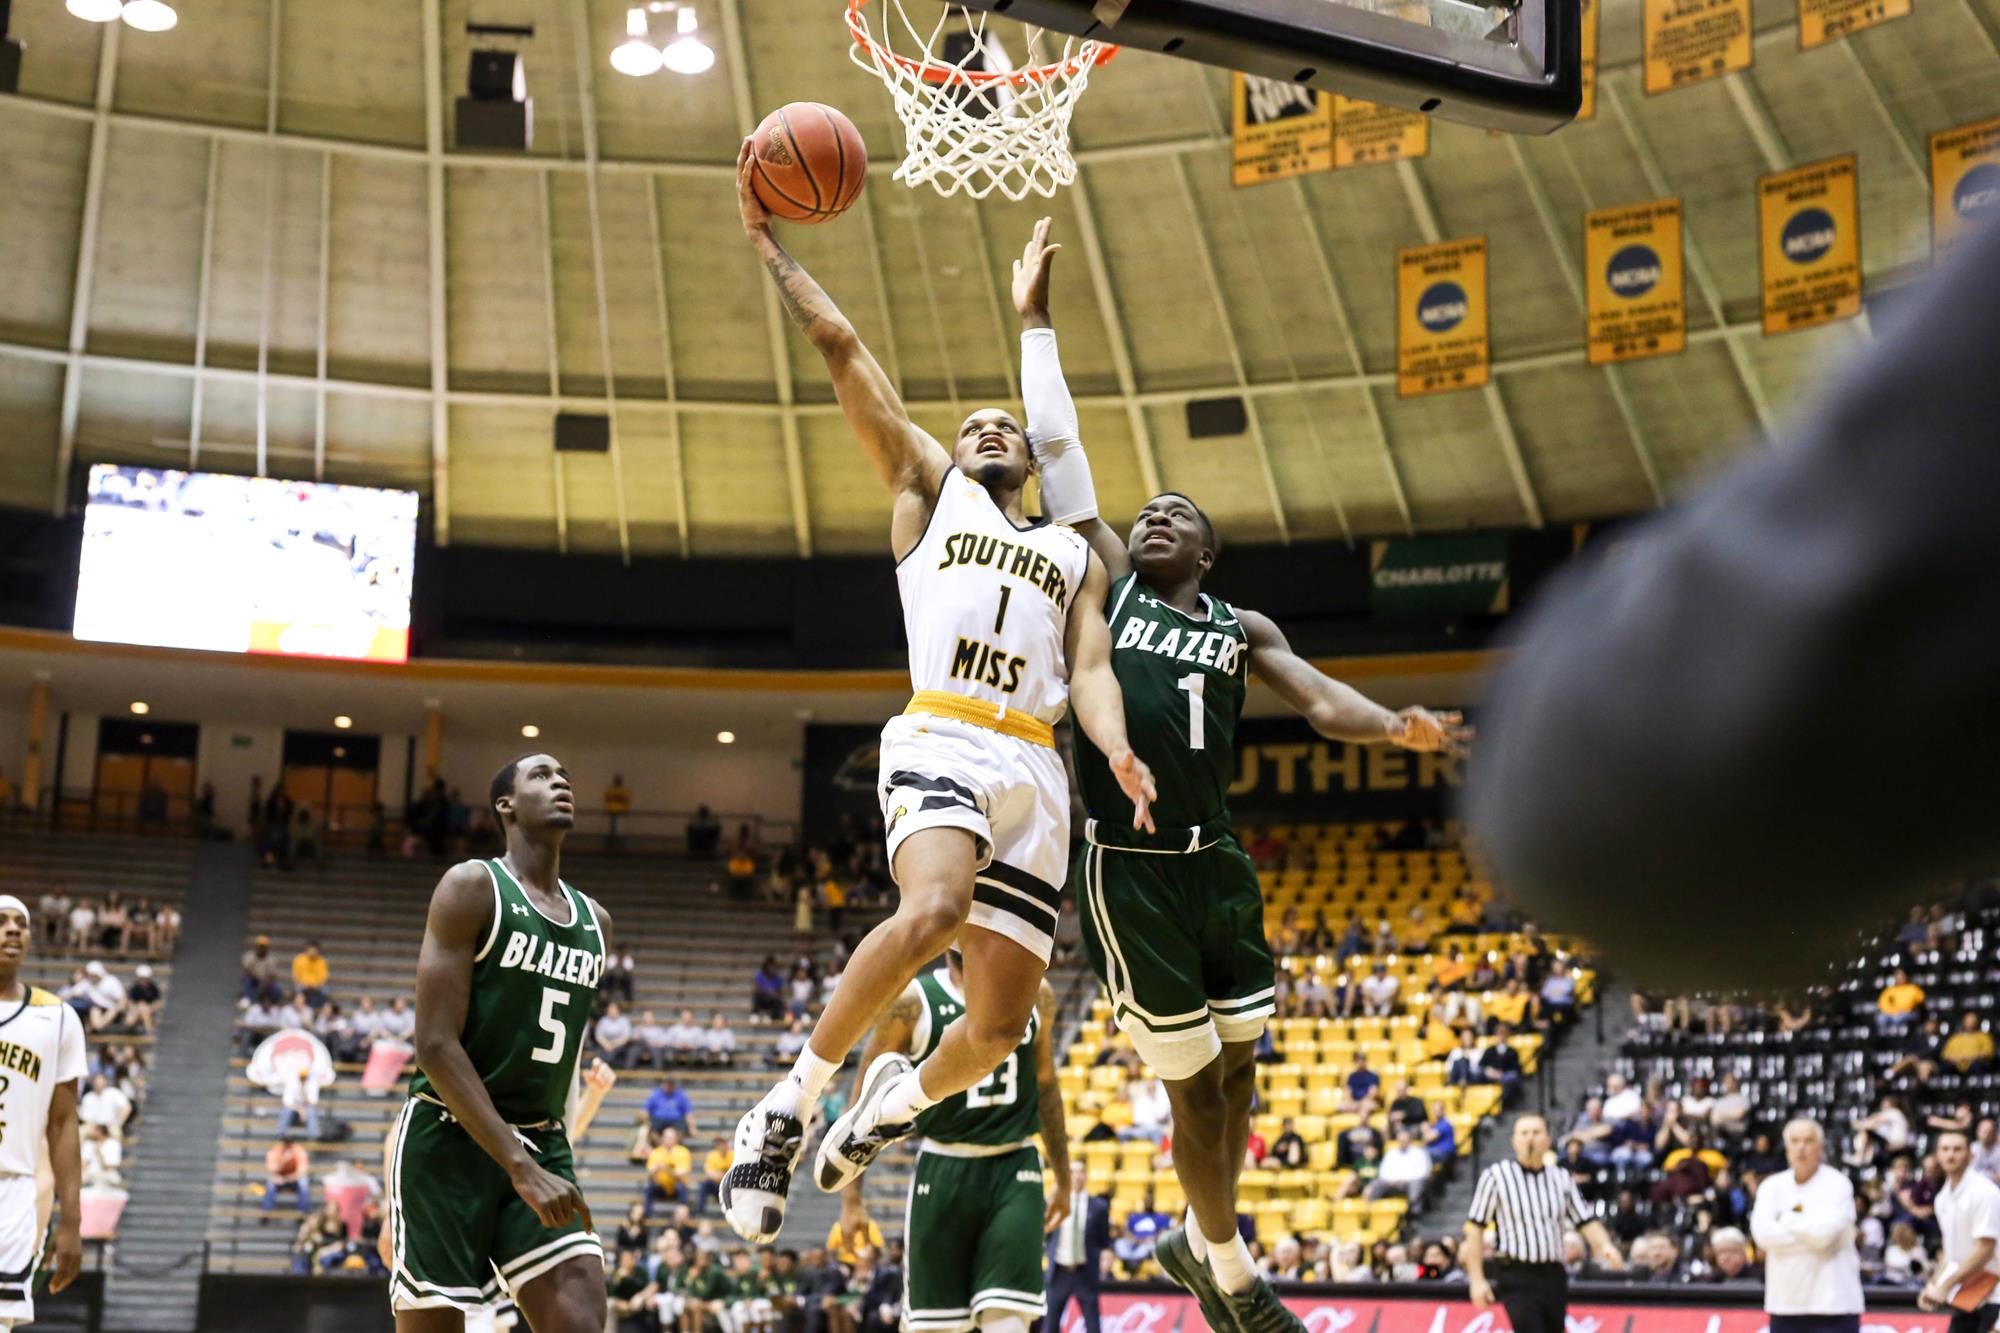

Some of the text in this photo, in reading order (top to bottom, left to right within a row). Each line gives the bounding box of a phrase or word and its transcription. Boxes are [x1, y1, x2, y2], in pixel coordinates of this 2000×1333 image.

[938, 532, 1067, 615] SOUTHERN
[1374, 561, 1504, 588] CHARLOTTE
[994, 585, 1012, 635] 1
[950, 637, 1026, 693] MISS
[1115, 616, 1248, 676] BLAZERS
[1177, 672, 1205, 750] 1
[1230, 743, 1466, 795] UTHER
[500, 930, 602, 989] BLAZERS
[531, 986, 591, 1064] 5
[0, 1040, 41, 1083] HERN
[966, 1051, 1018, 1109] 23
